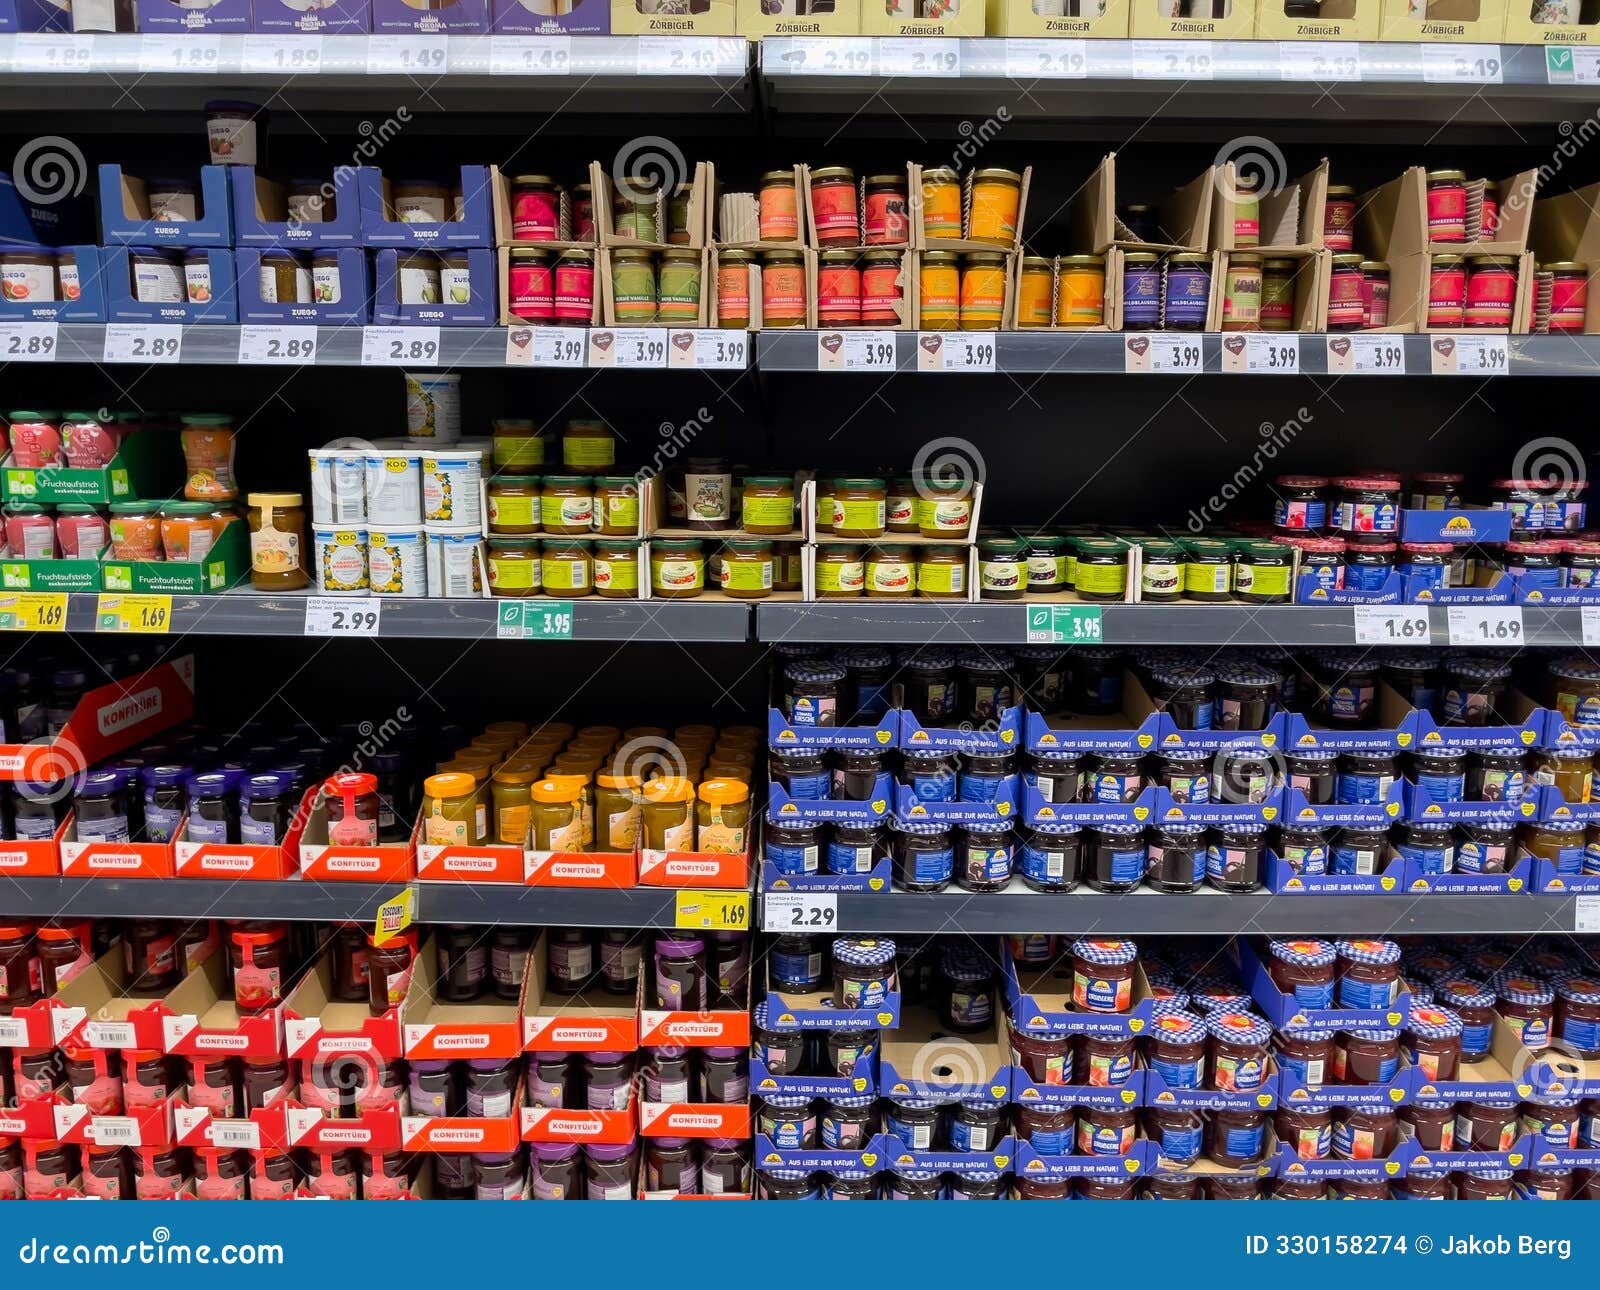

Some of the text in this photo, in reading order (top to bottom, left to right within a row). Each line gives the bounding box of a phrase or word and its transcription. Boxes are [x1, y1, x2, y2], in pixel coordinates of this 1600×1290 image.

[181, 17, 212, 25] ROKOMA
[414, 21, 447, 30] ROKOMA
[649, 20, 694, 30] ZÖRBIGER
[775, 23, 820, 33] ZÖRBIGER
[1046, 21, 1090, 31] ZÖRBIGER
[1171, 22, 1215, 33] ZÖRBIGER
[1421, 24, 1465, 34] ZÖRBIGER
[535, 26, 567, 34] ROKOMA
[900, 25, 945, 35] ZÖRBIGER
[1297, 25, 1340, 35] ZÖRBIGER
[1544, 31, 1587, 41] ZÖRBIGER
[400, 49, 445, 67] 1.49
[522, 50, 568, 68] 1.49
[825, 51, 870, 70] 2.19
[911, 52, 957, 71] 2.19
[1038, 54, 1084, 72] 2.19
[1456, 59, 1499, 77] 2.19
[8, 337, 54, 354] 2.89
[132, 339, 178, 356] 2.89
[267, 340, 313, 357] 2.89
[390, 341, 436, 358] 2.89
[554, 341, 581, 360] 3.99
[637, 342, 663, 361] 3.99
[717, 343, 743, 361] 3.99
[866, 344, 893, 364] 3.99
[966, 345, 992, 364] 3.99
[1173, 347, 1199, 366] 3.99
[1269, 347, 1295, 367] 3.99
[1375, 347, 1400, 367] 3.99
[1479, 349, 1505, 368] 3.99
[43, 480, 99, 489] Fruchtaufstrich
[37, 573, 92, 582] Fruchtaufstrich
[139, 576, 194, 585] Fruchtaufstrich
[1488, 594, 1507, 602] NATUR!
[38, 606, 62, 625] 1.69
[142, 608, 165, 627] 1.69
[332, 612, 377, 629] 2.99
[543, 614, 570, 634] 3.95
[500, 627, 516, 635] BIO
[1030, 632, 1046, 640] BIO
[1073, 618, 1100, 637] 3.95
[1385, 620, 1427, 638] 1.69
[1479, 621, 1520, 638] 1.69
[103, 694, 158, 726] KONFITÜRE
[849, 736, 870, 744] NATUR!
[206, 858, 250, 866] KONFITÜRE
[331, 860, 376, 868] KONFITÜRE
[448, 860, 493, 868] KONFITÜRE
[555, 865, 601, 874] KONFITÜRE
[670, 864, 715, 872] KONFITÜRE
[722, 905, 744, 924] 1.69
[791, 908, 834, 926] 2.29
